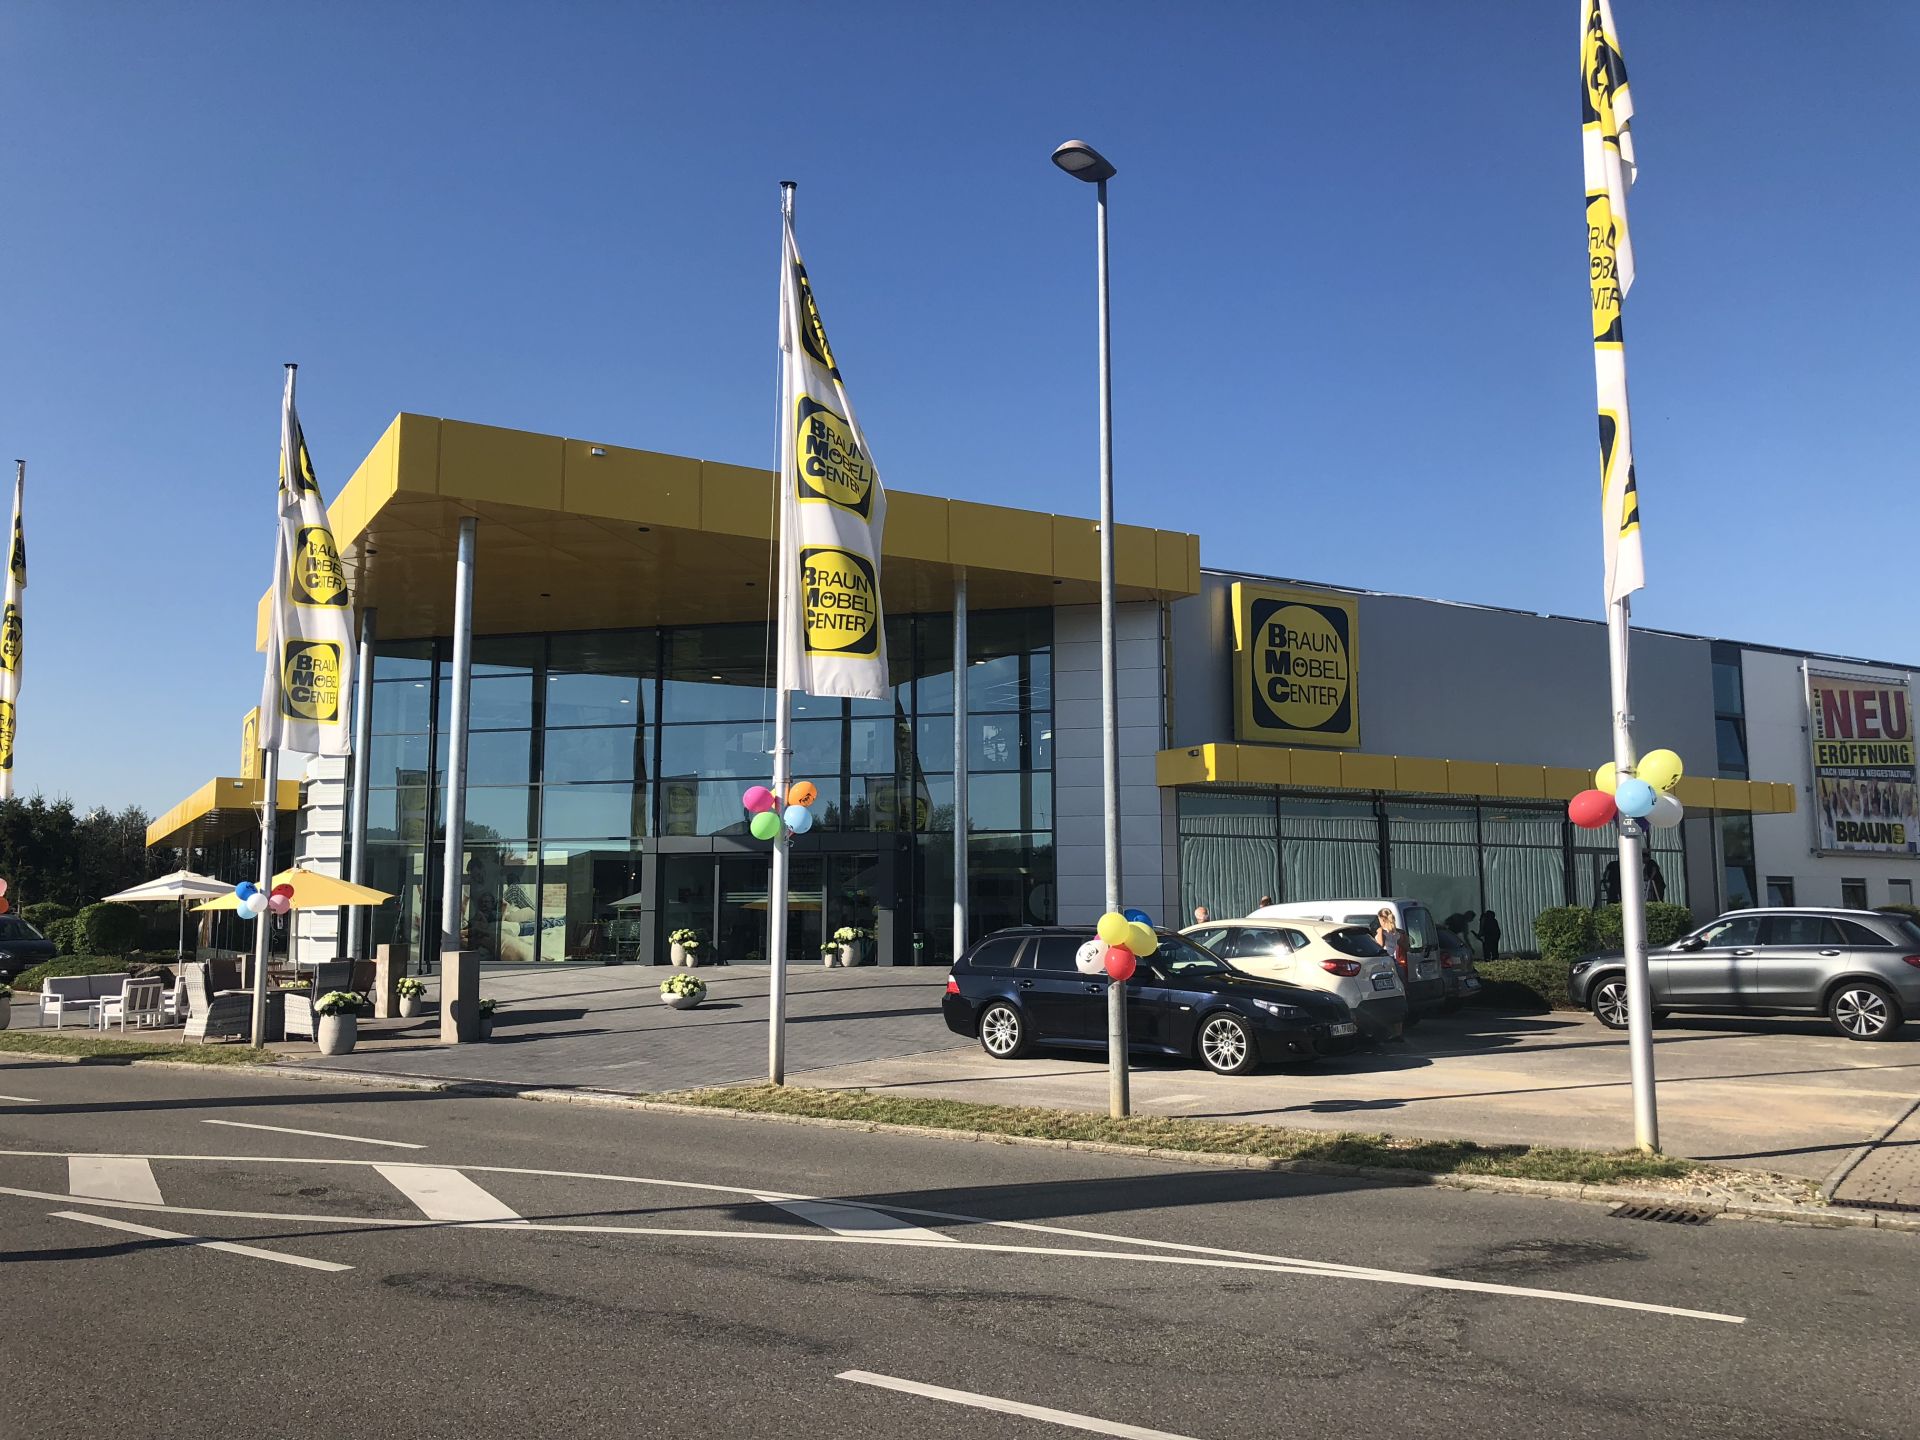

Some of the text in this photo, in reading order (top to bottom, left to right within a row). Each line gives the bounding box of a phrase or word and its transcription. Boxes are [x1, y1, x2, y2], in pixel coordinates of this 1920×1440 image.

[811, 416, 864, 460] BRAUN
[806, 456, 860, 494] CENTER
[806, 567, 868, 593] BRAUN
[1268, 623, 1338, 653] BRAUN
[1267, 677, 1338, 706] CENTER
[1821, 689, 1907, 740] NEU
[1818, 741, 1909, 764] ERÖFFNUNG
[1821, 767, 1837, 777] NACH
[1866, 769, 1911, 778] NEUGESTALTUNG
[1836, 820, 1893, 843] BRAUN
